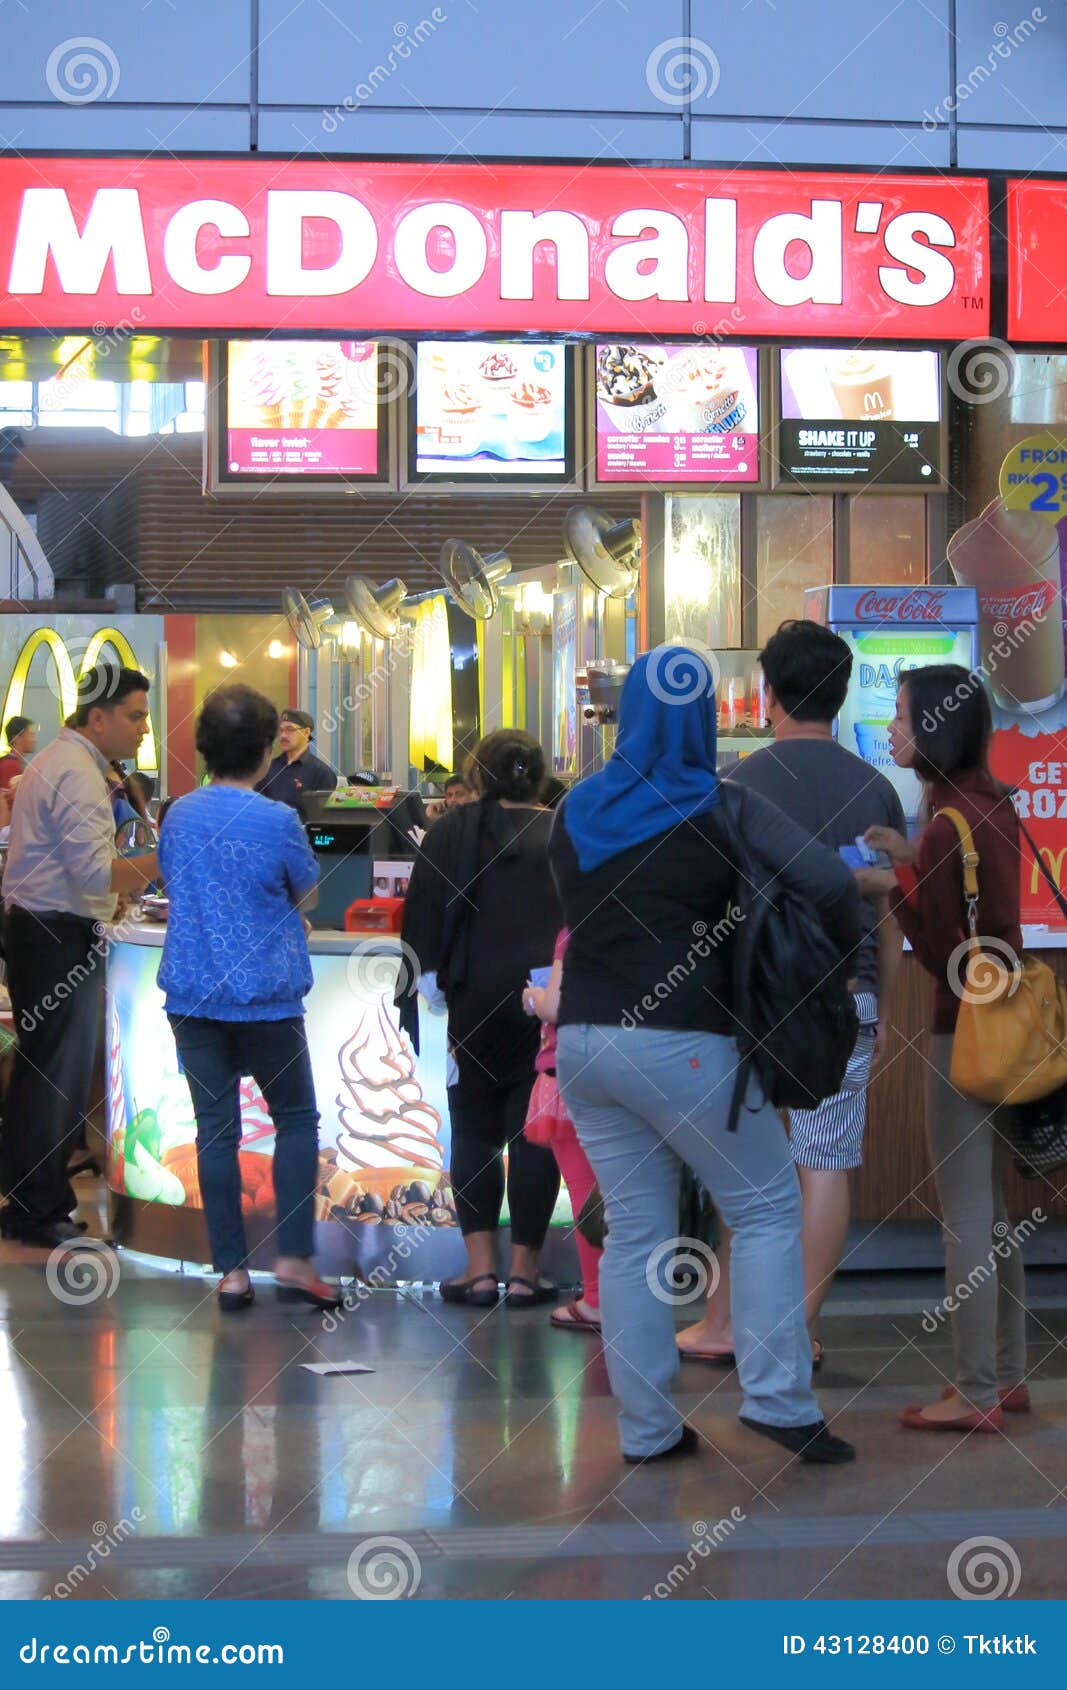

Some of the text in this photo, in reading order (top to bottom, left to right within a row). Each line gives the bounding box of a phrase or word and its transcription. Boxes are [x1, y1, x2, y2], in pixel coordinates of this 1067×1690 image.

[8, 187, 955, 306] McDonald's
[798, 430, 876, 447] SHAKE IT UP
